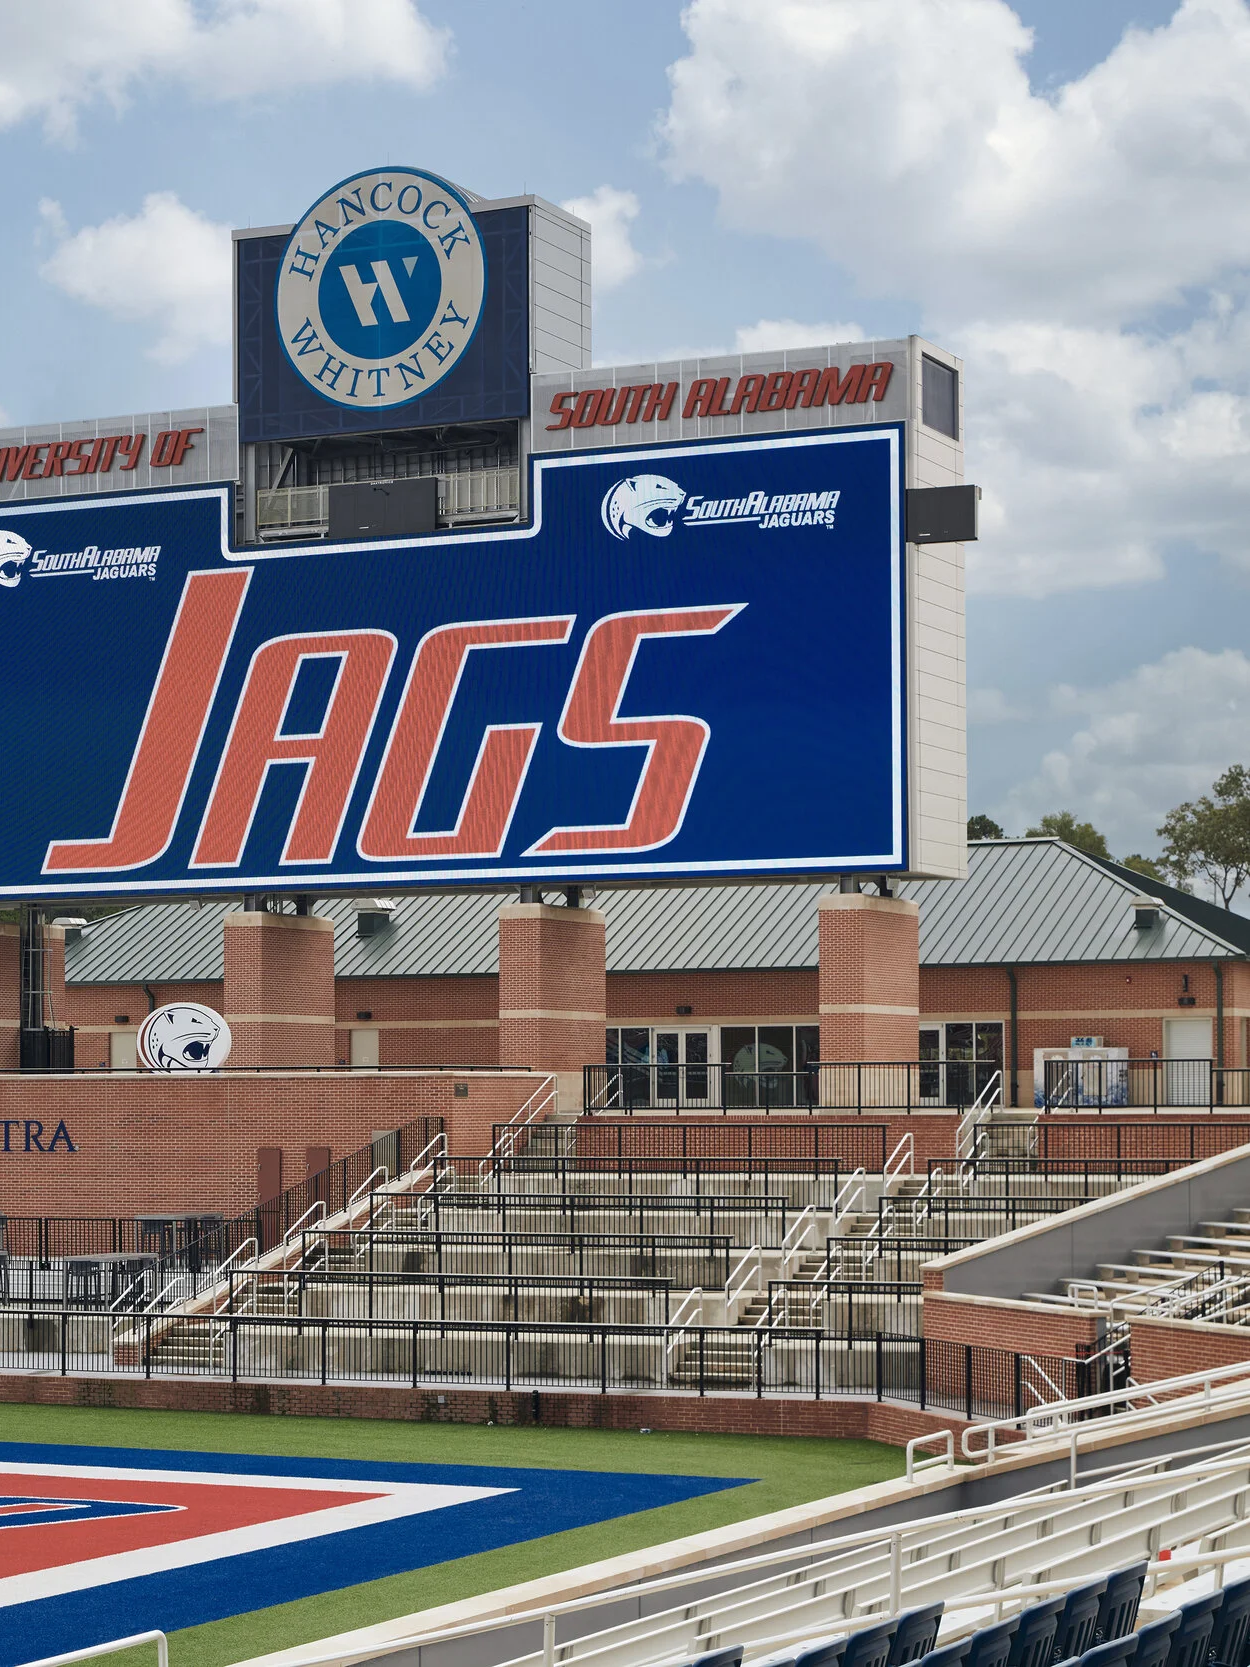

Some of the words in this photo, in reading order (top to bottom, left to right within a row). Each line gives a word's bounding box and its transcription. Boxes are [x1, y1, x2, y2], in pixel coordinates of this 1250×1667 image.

[288, 181, 471, 282] HANCOCK
[290, 300, 470, 398] WHITNEY
[545, 382, 679, 431] SOUTH
[682, 362, 894, 419] ALABAMA
[150, 427, 206, 468] OF
[758, 509, 835, 529] JAGUARS
[92, 562, 157, 581] JAGUARS
[40, 565, 749, 875] JAGS
